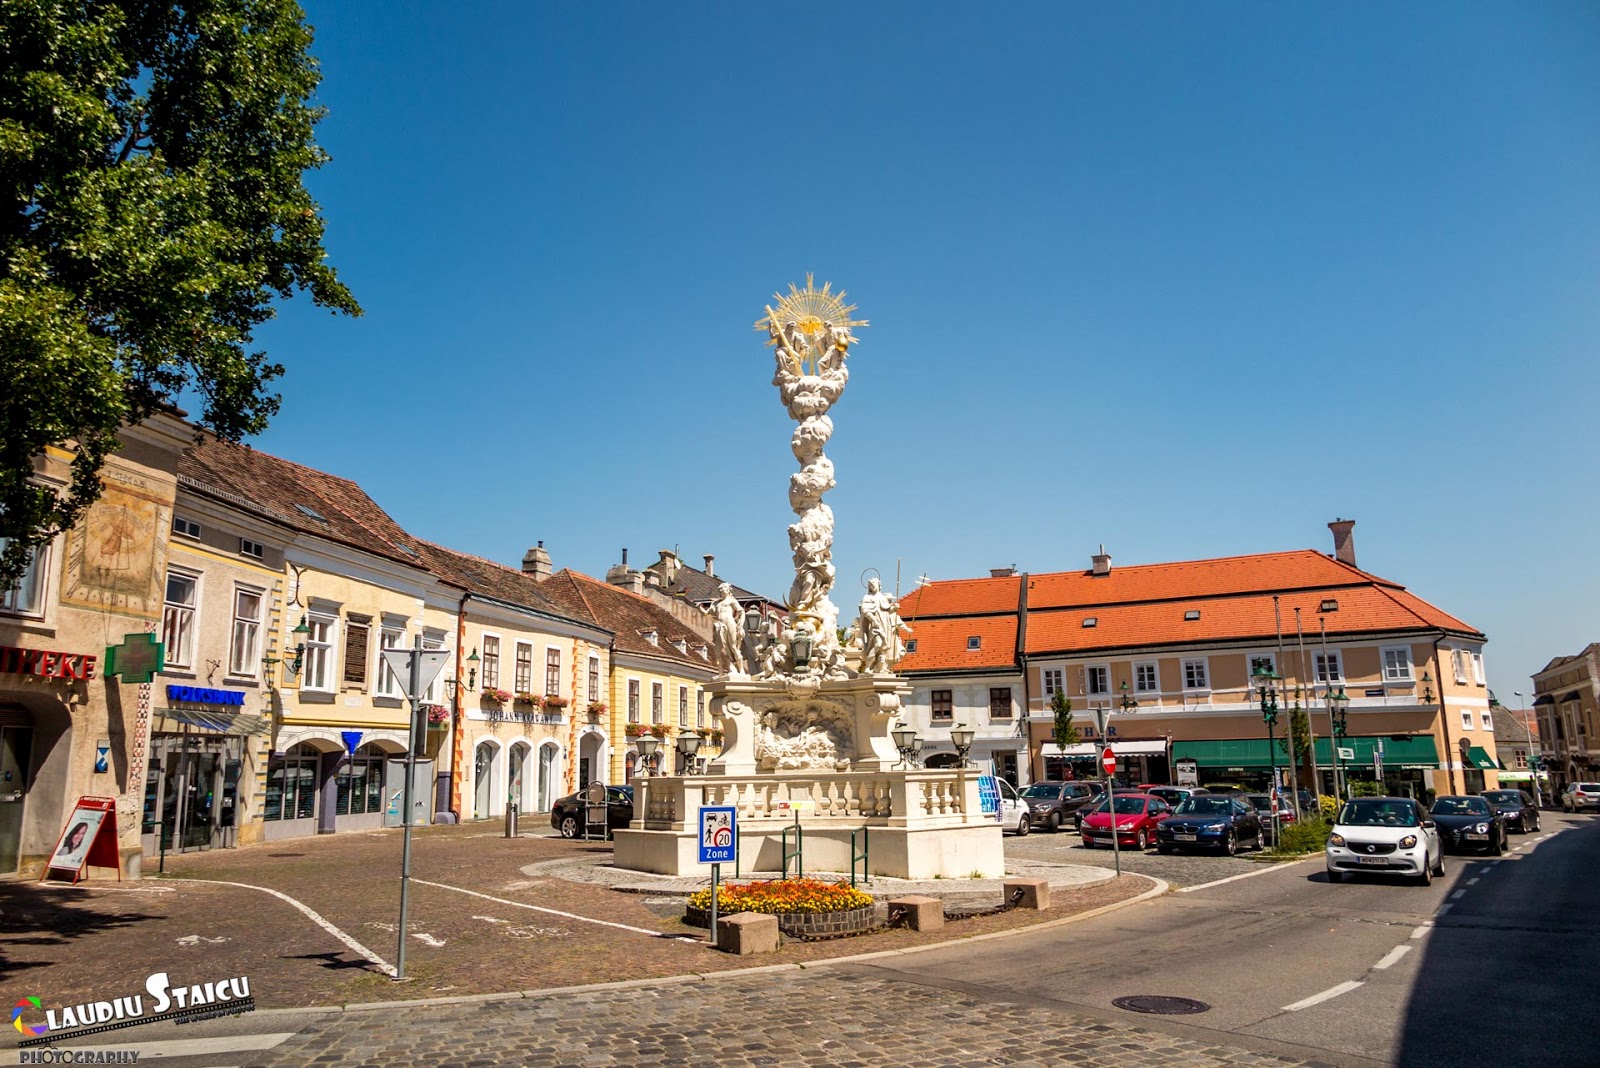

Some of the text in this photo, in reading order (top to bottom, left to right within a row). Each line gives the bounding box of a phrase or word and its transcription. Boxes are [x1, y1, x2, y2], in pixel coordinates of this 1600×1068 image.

[166, 684, 246, 706] VOLKSBANK
[489, 710, 519, 722] JOHANN
[718, 833, 730, 846] 20
[706, 848, 729, 859] Zone
